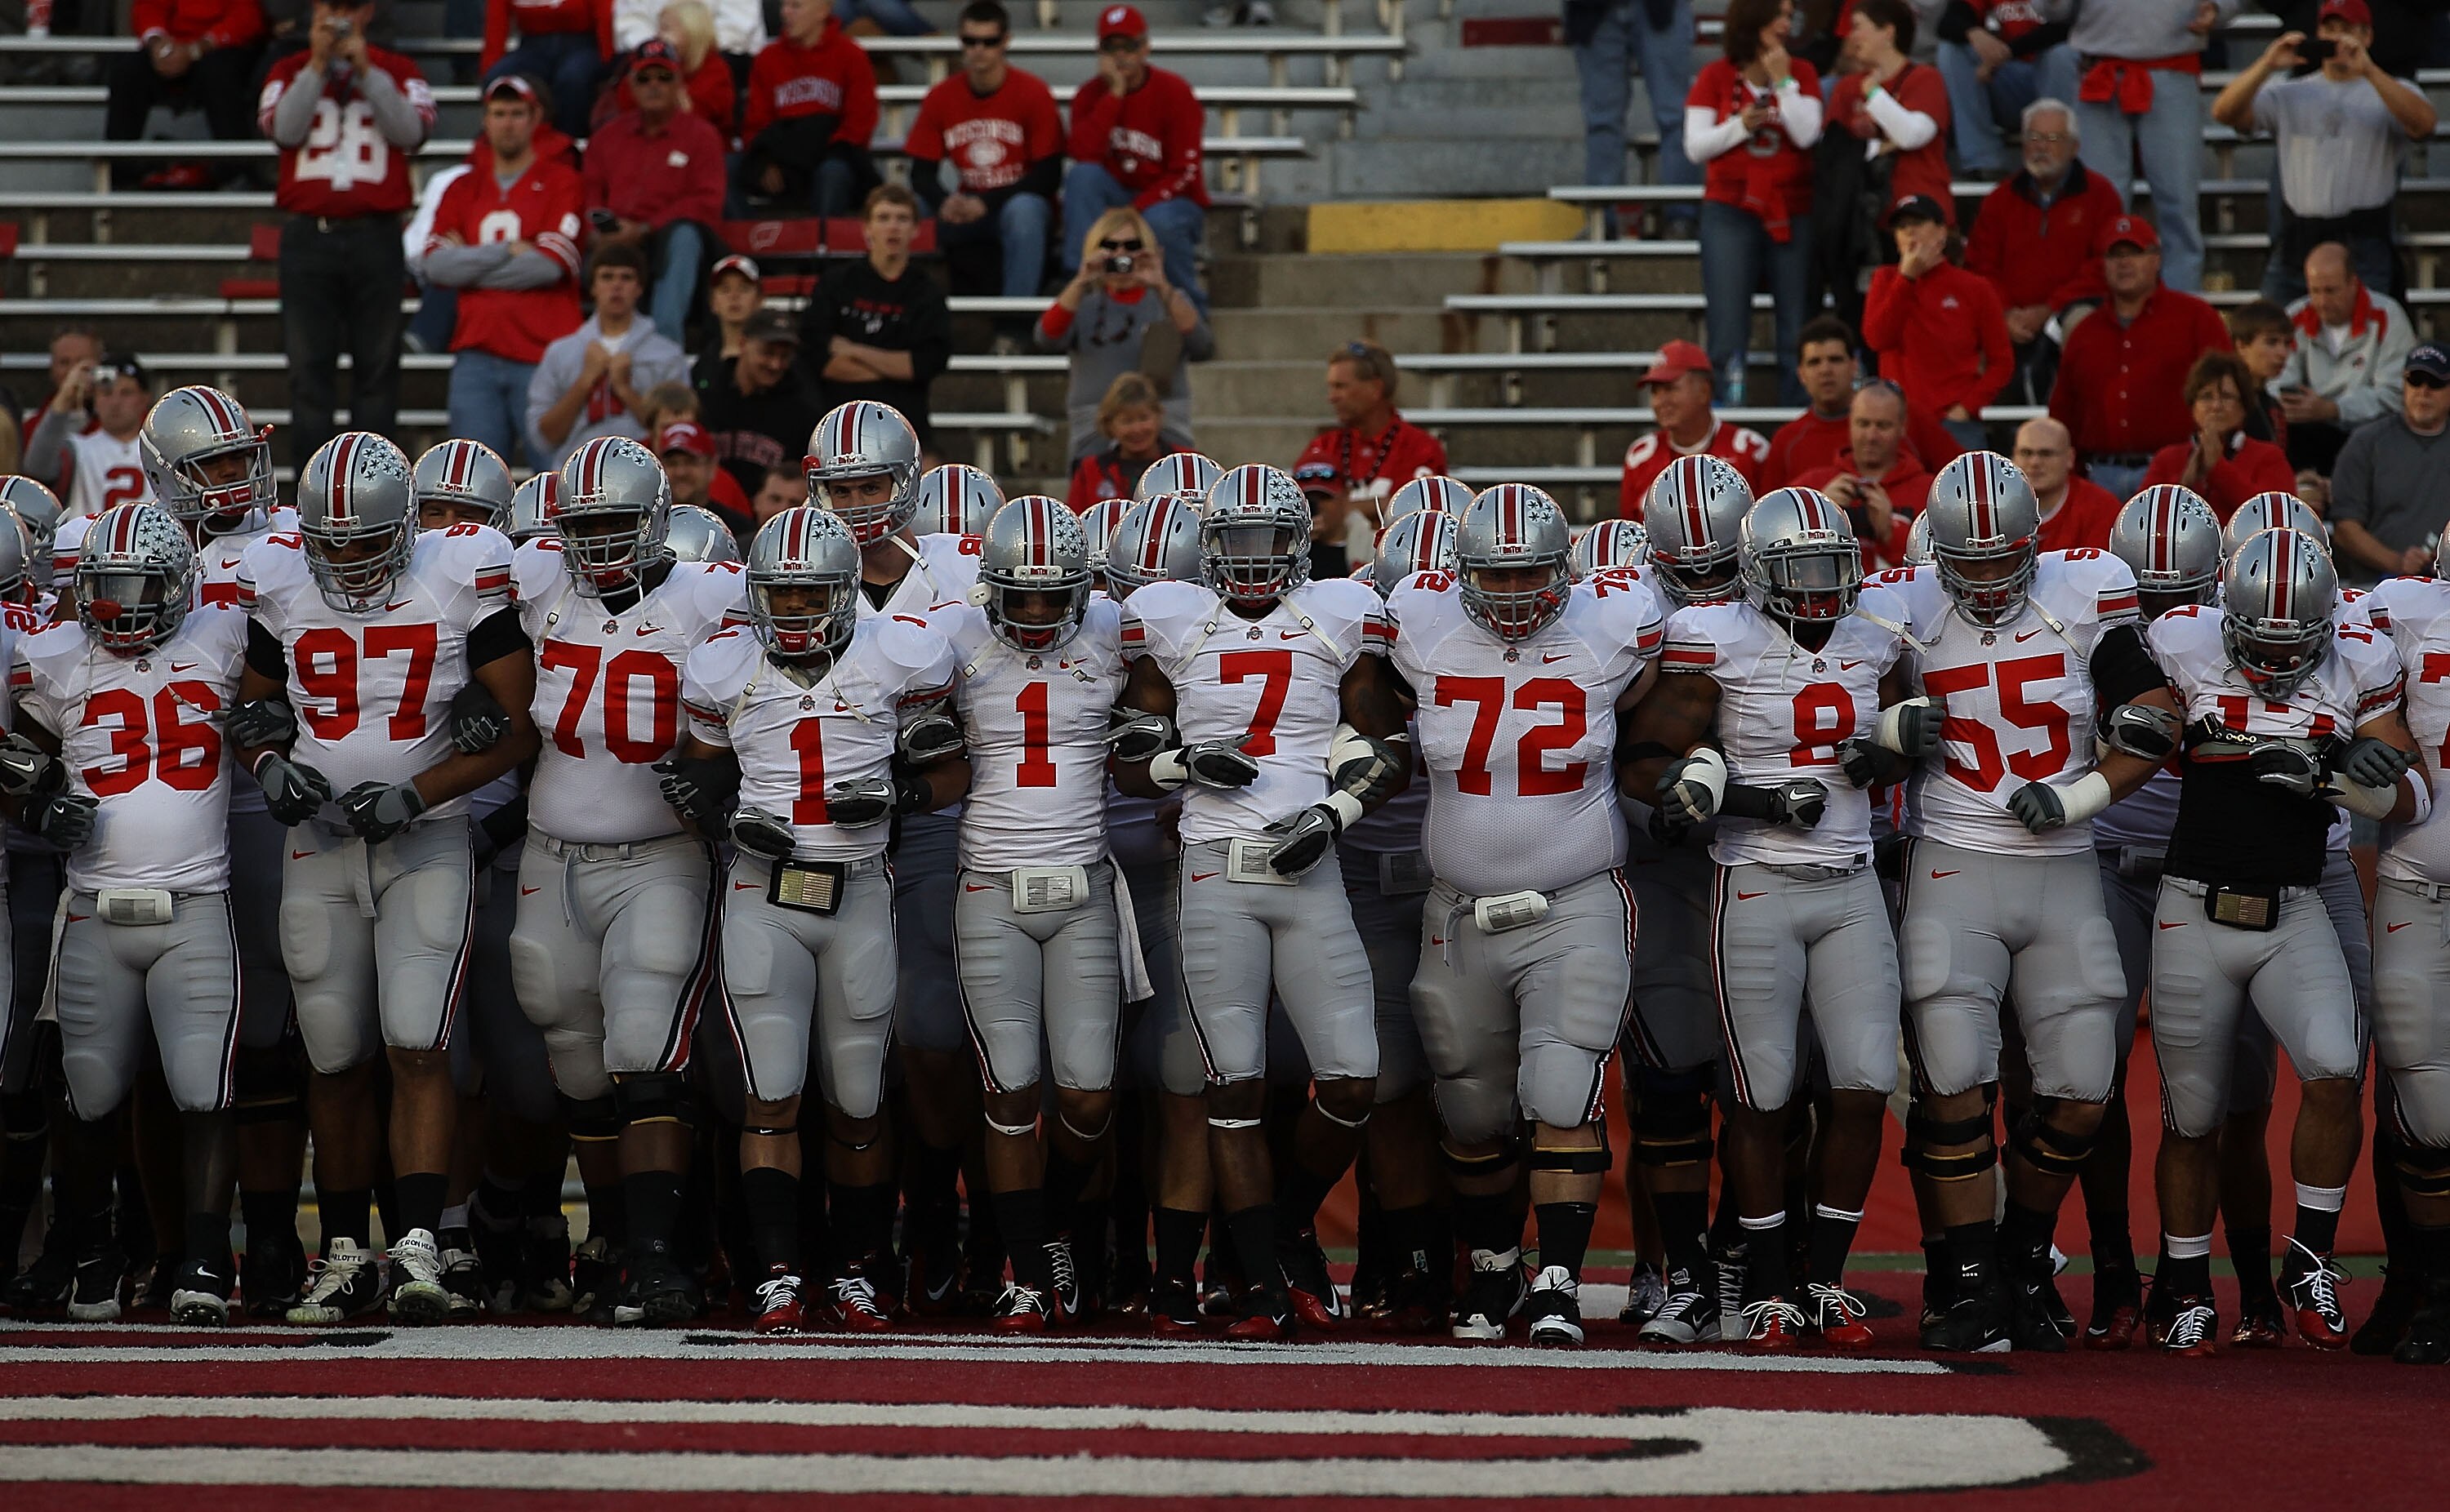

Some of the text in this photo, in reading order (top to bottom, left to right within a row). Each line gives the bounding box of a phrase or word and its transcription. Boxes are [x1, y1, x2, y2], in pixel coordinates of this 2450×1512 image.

[79, 680, 222, 798] 36
[292, 623, 439, 741] 97
[540, 638, 679, 765] 70
[1015, 682, 1056, 788] 1
[1218, 651, 1293, 757] 7
[1434, 676, 1588, 797] 72
[1789, 682, 1856, 768] 8
[1922, 652, 2071, 793] 55
[790, 718, 835, 826] 1
